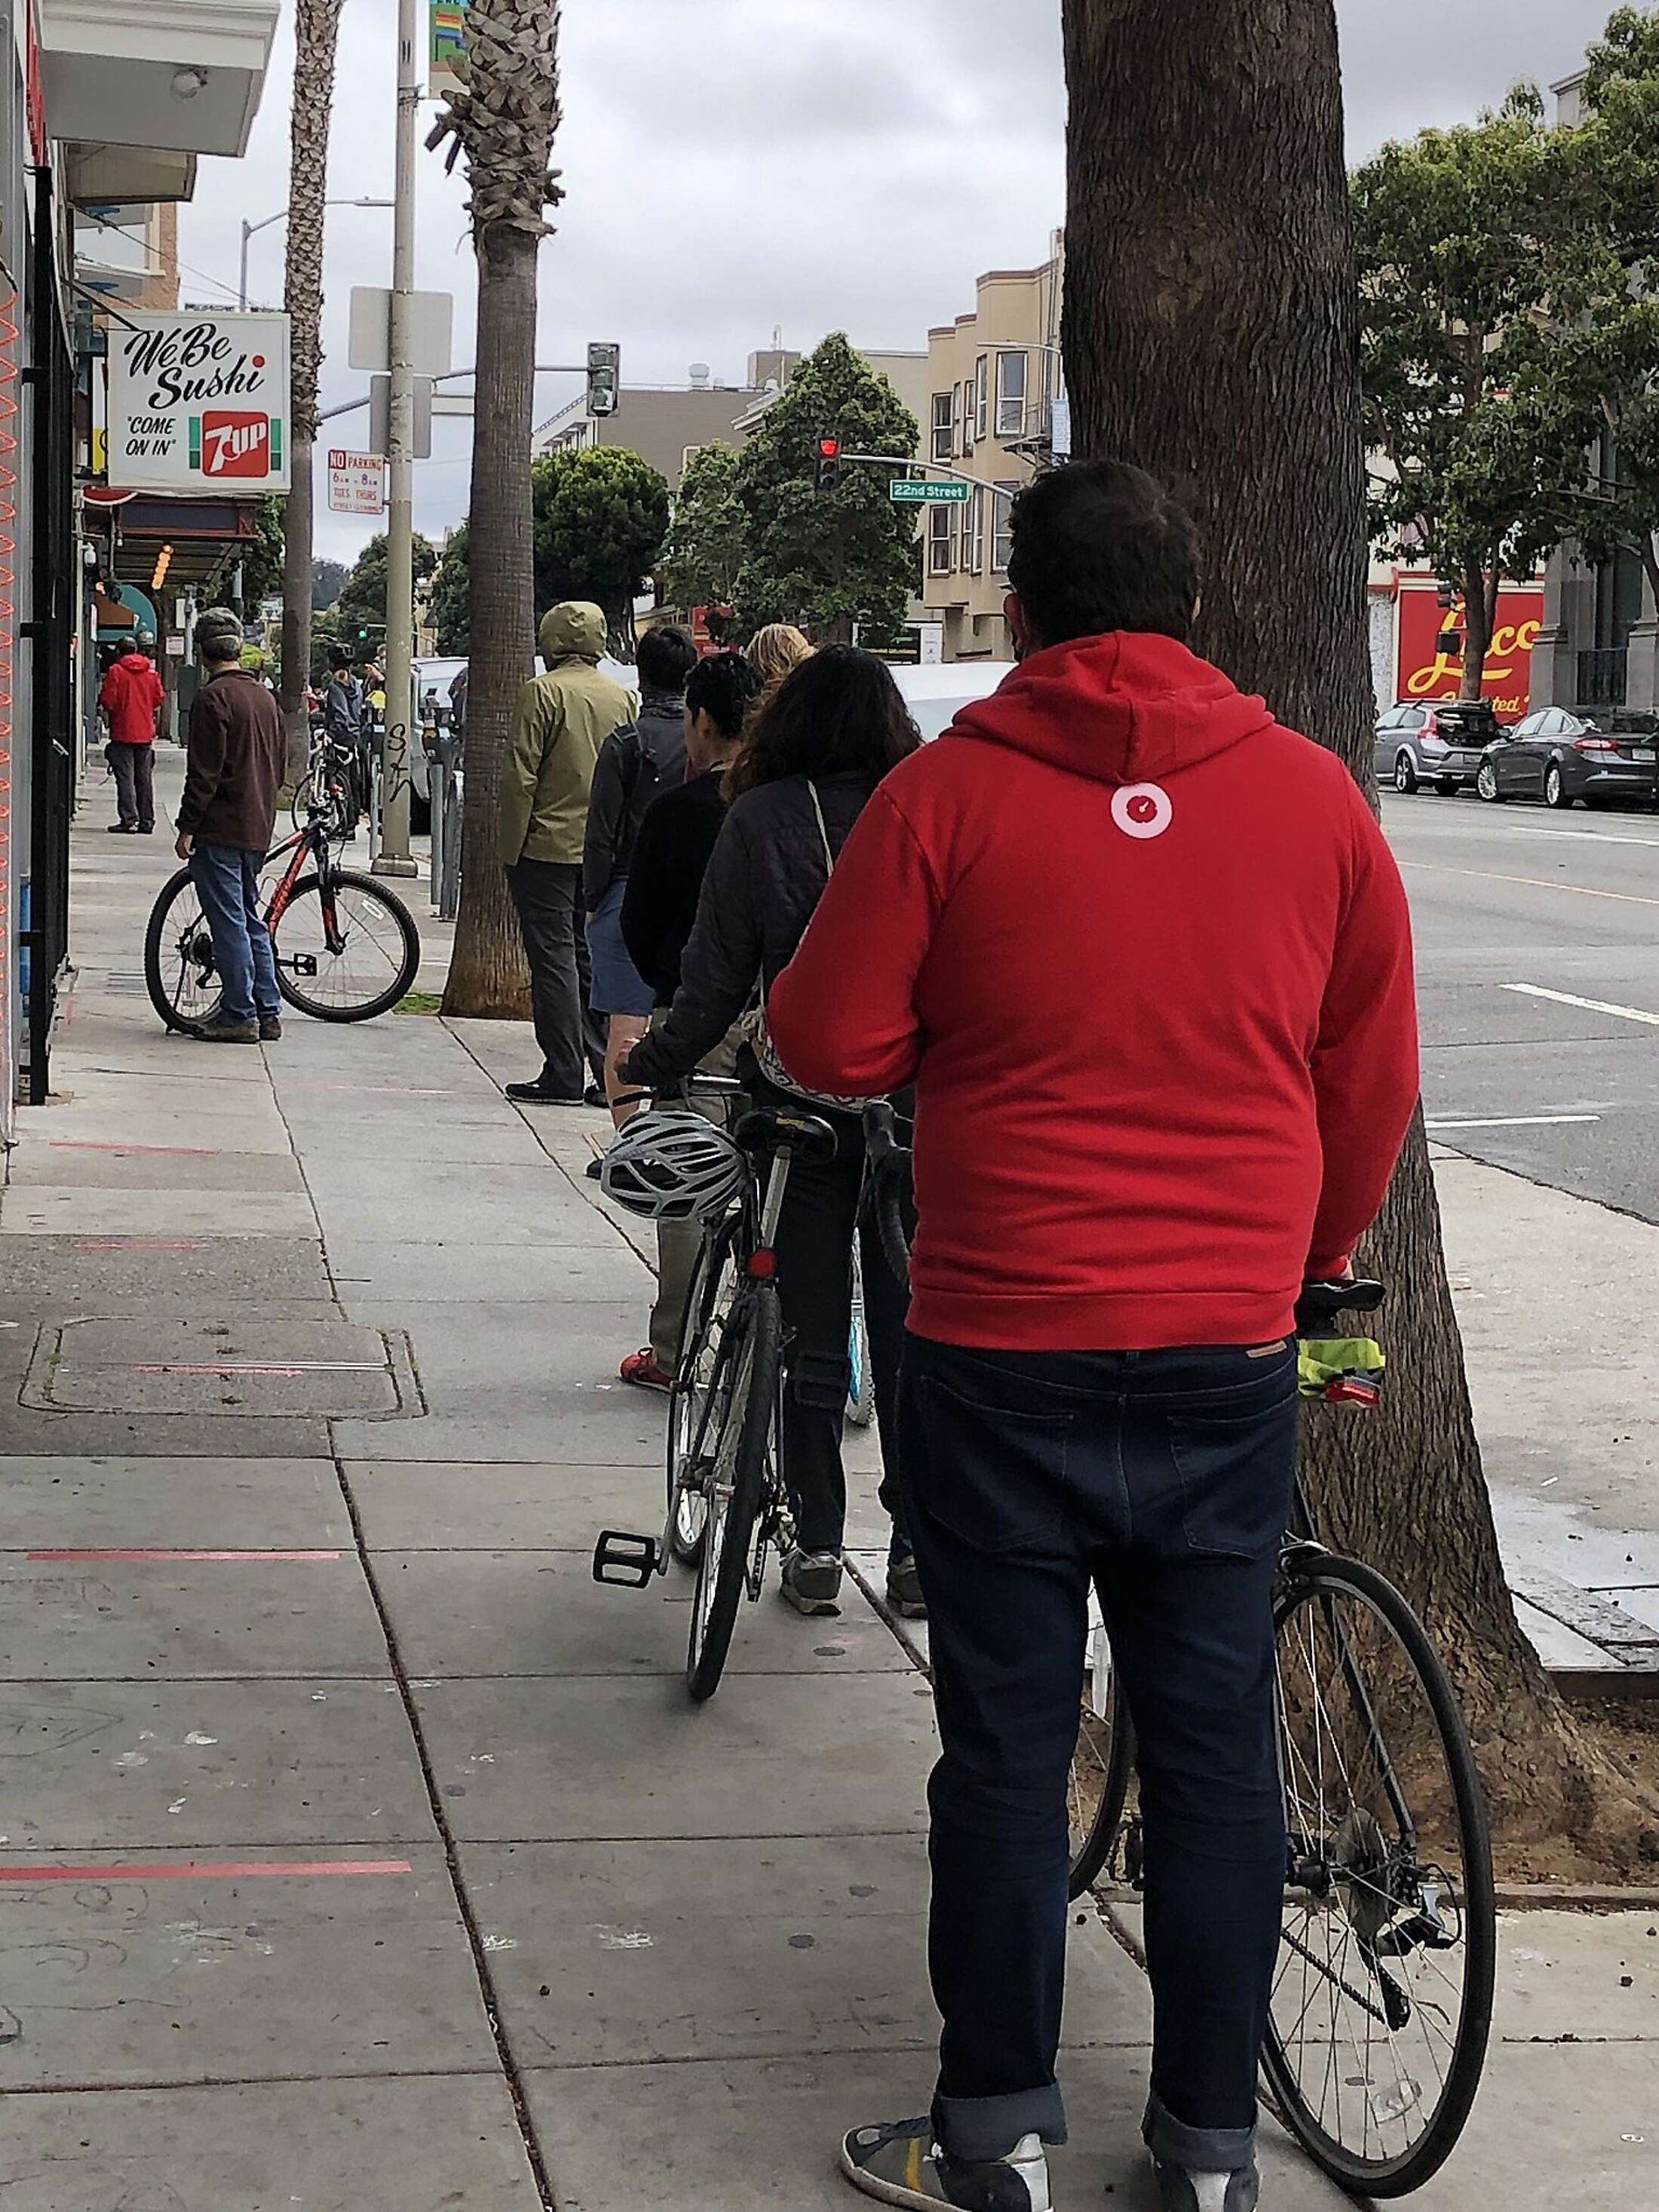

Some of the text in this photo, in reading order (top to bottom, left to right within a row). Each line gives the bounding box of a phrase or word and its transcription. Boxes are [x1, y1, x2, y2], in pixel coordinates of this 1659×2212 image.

[124, 323, 232, 377] We Be
[148, 354, 265, 410] Sushi
[125, 439, 150, 456] ON
[330, 451, 382, 471] NO PARKING
[894, 484, 963, 498] 22nd Street
